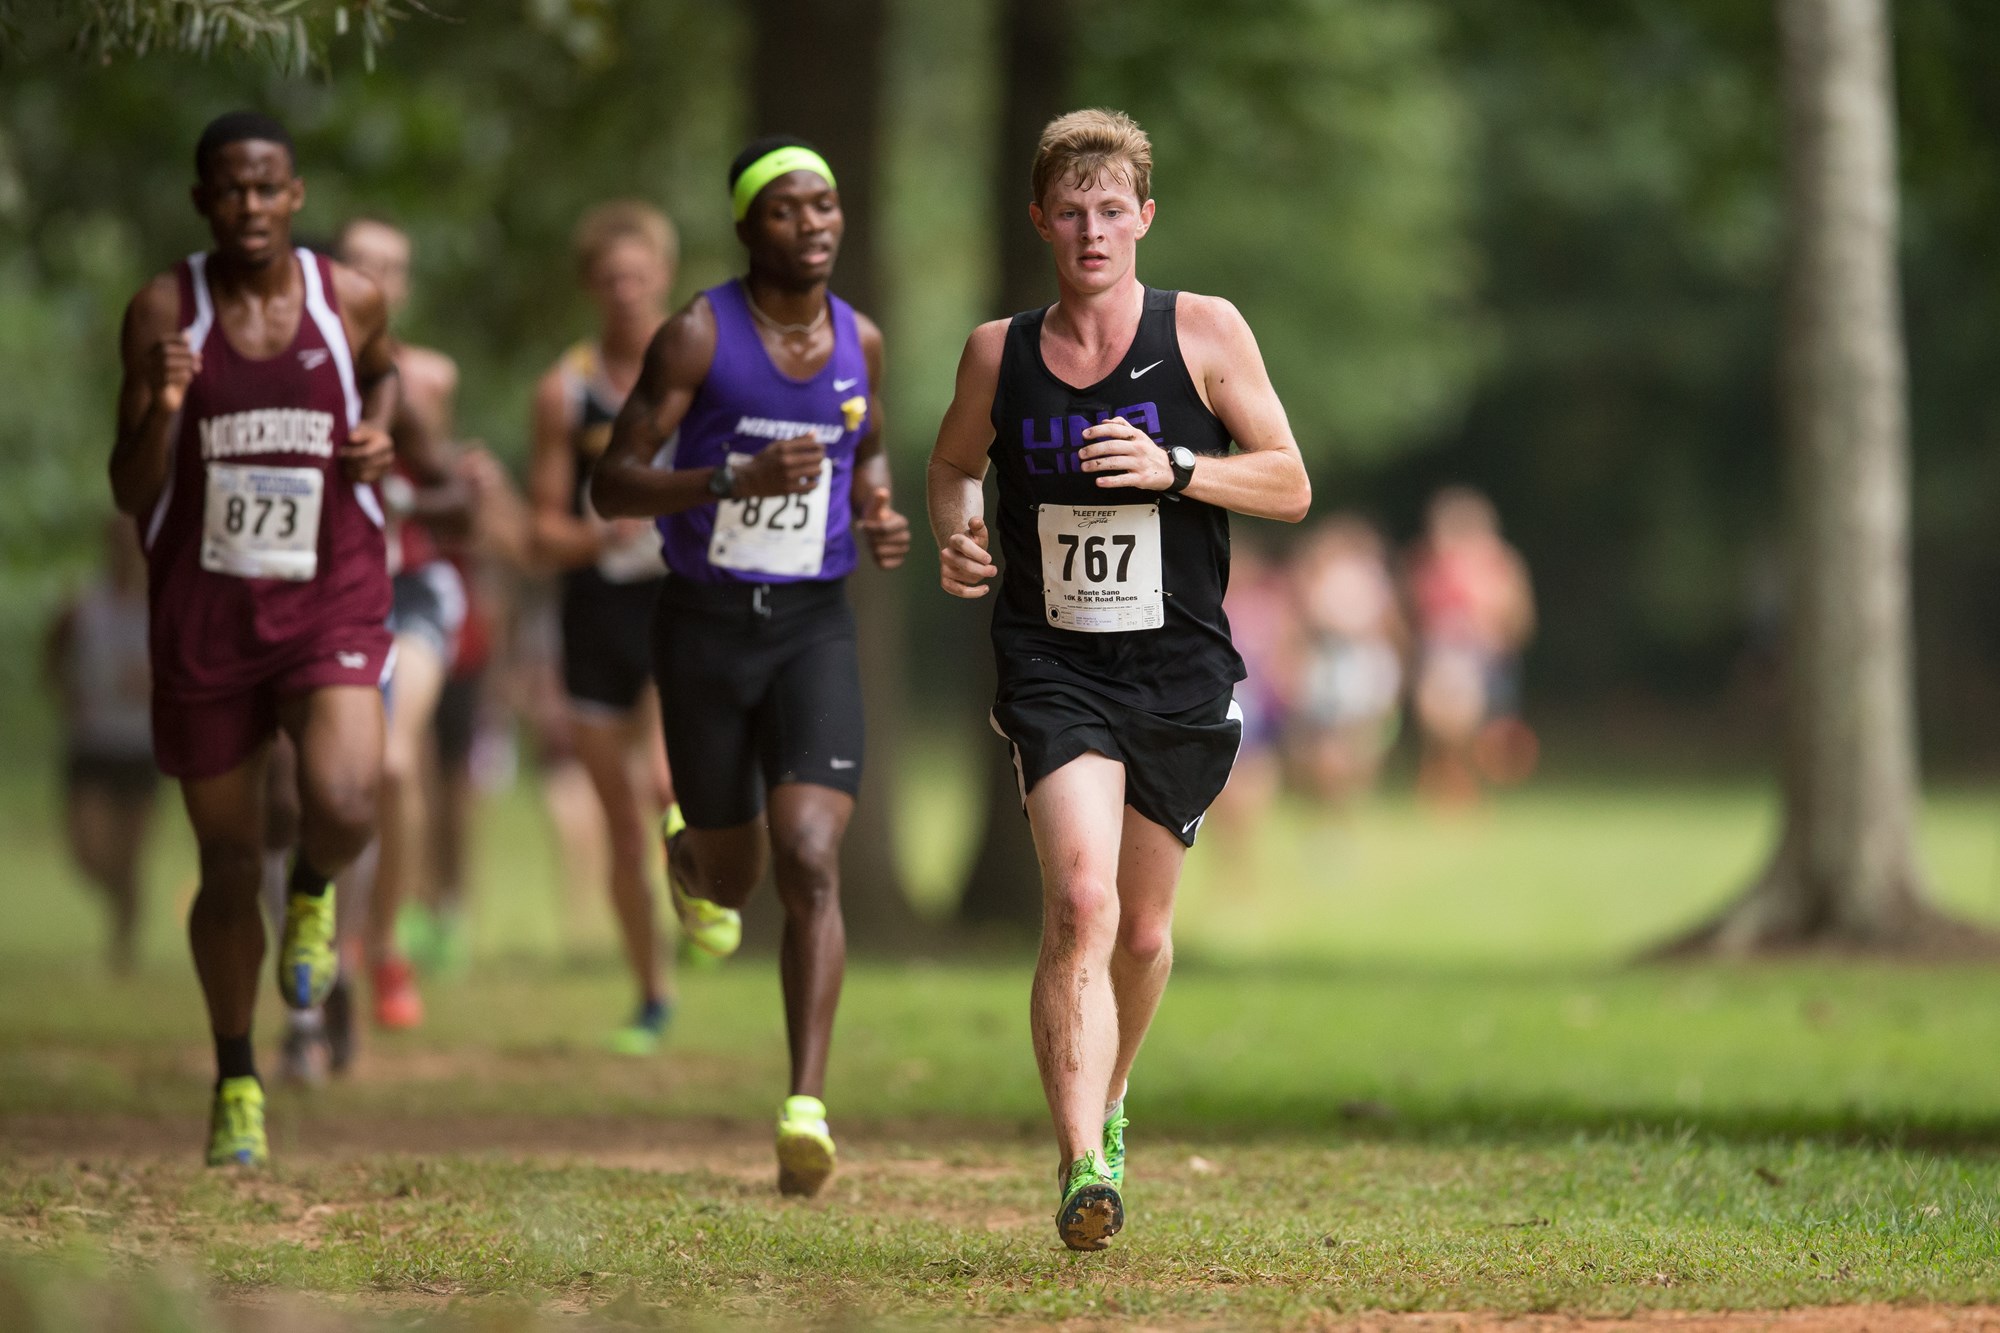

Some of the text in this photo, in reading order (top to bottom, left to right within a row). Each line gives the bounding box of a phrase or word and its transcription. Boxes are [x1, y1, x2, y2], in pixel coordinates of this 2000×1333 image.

[199, 408, 334, 459] MOREHOUSE
[226, 495, 298, 538] 873
[742, 494, 808, 530] 825
[1073, 509, 1097, 517] FLEET
[1058, 534, 1136, 584] 767
